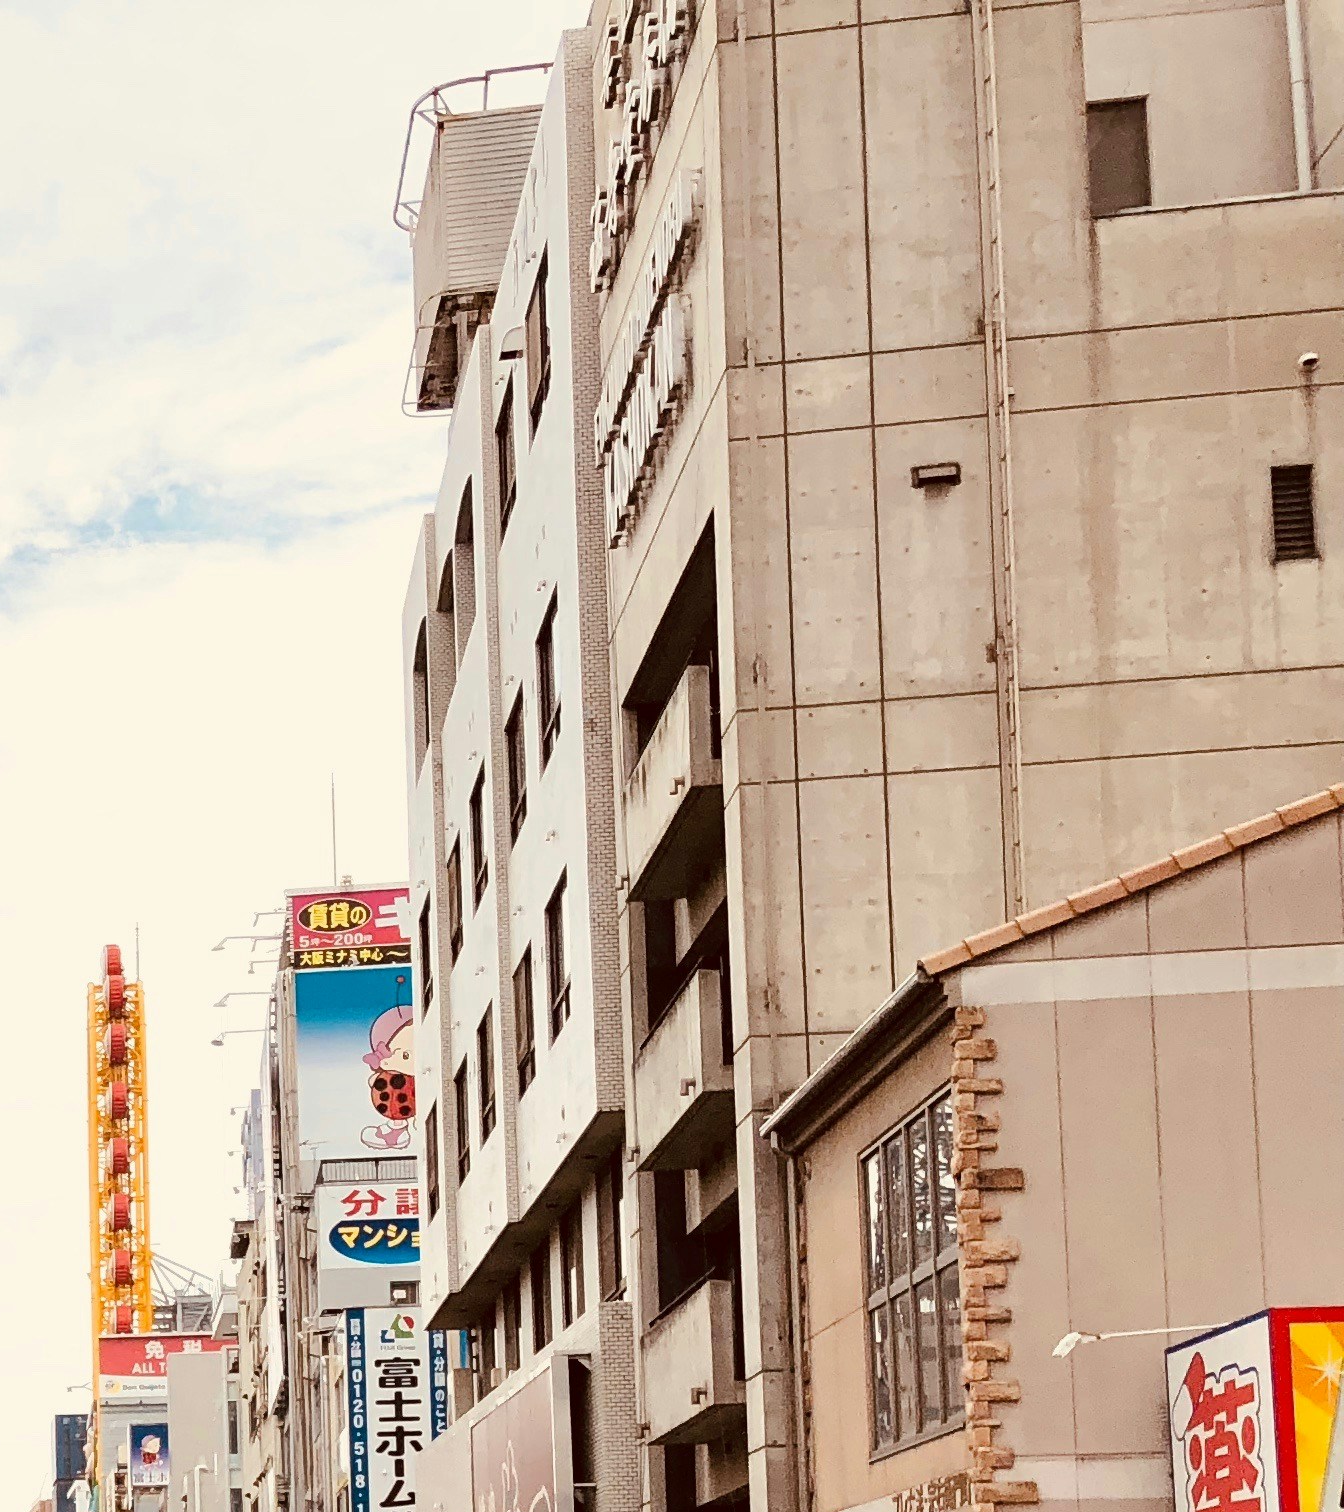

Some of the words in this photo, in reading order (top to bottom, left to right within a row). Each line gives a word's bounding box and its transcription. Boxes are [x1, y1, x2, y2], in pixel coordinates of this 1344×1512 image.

[308, 903, 366, 929] 賃貸の
[131, 1362, 155, 1374] ALL
